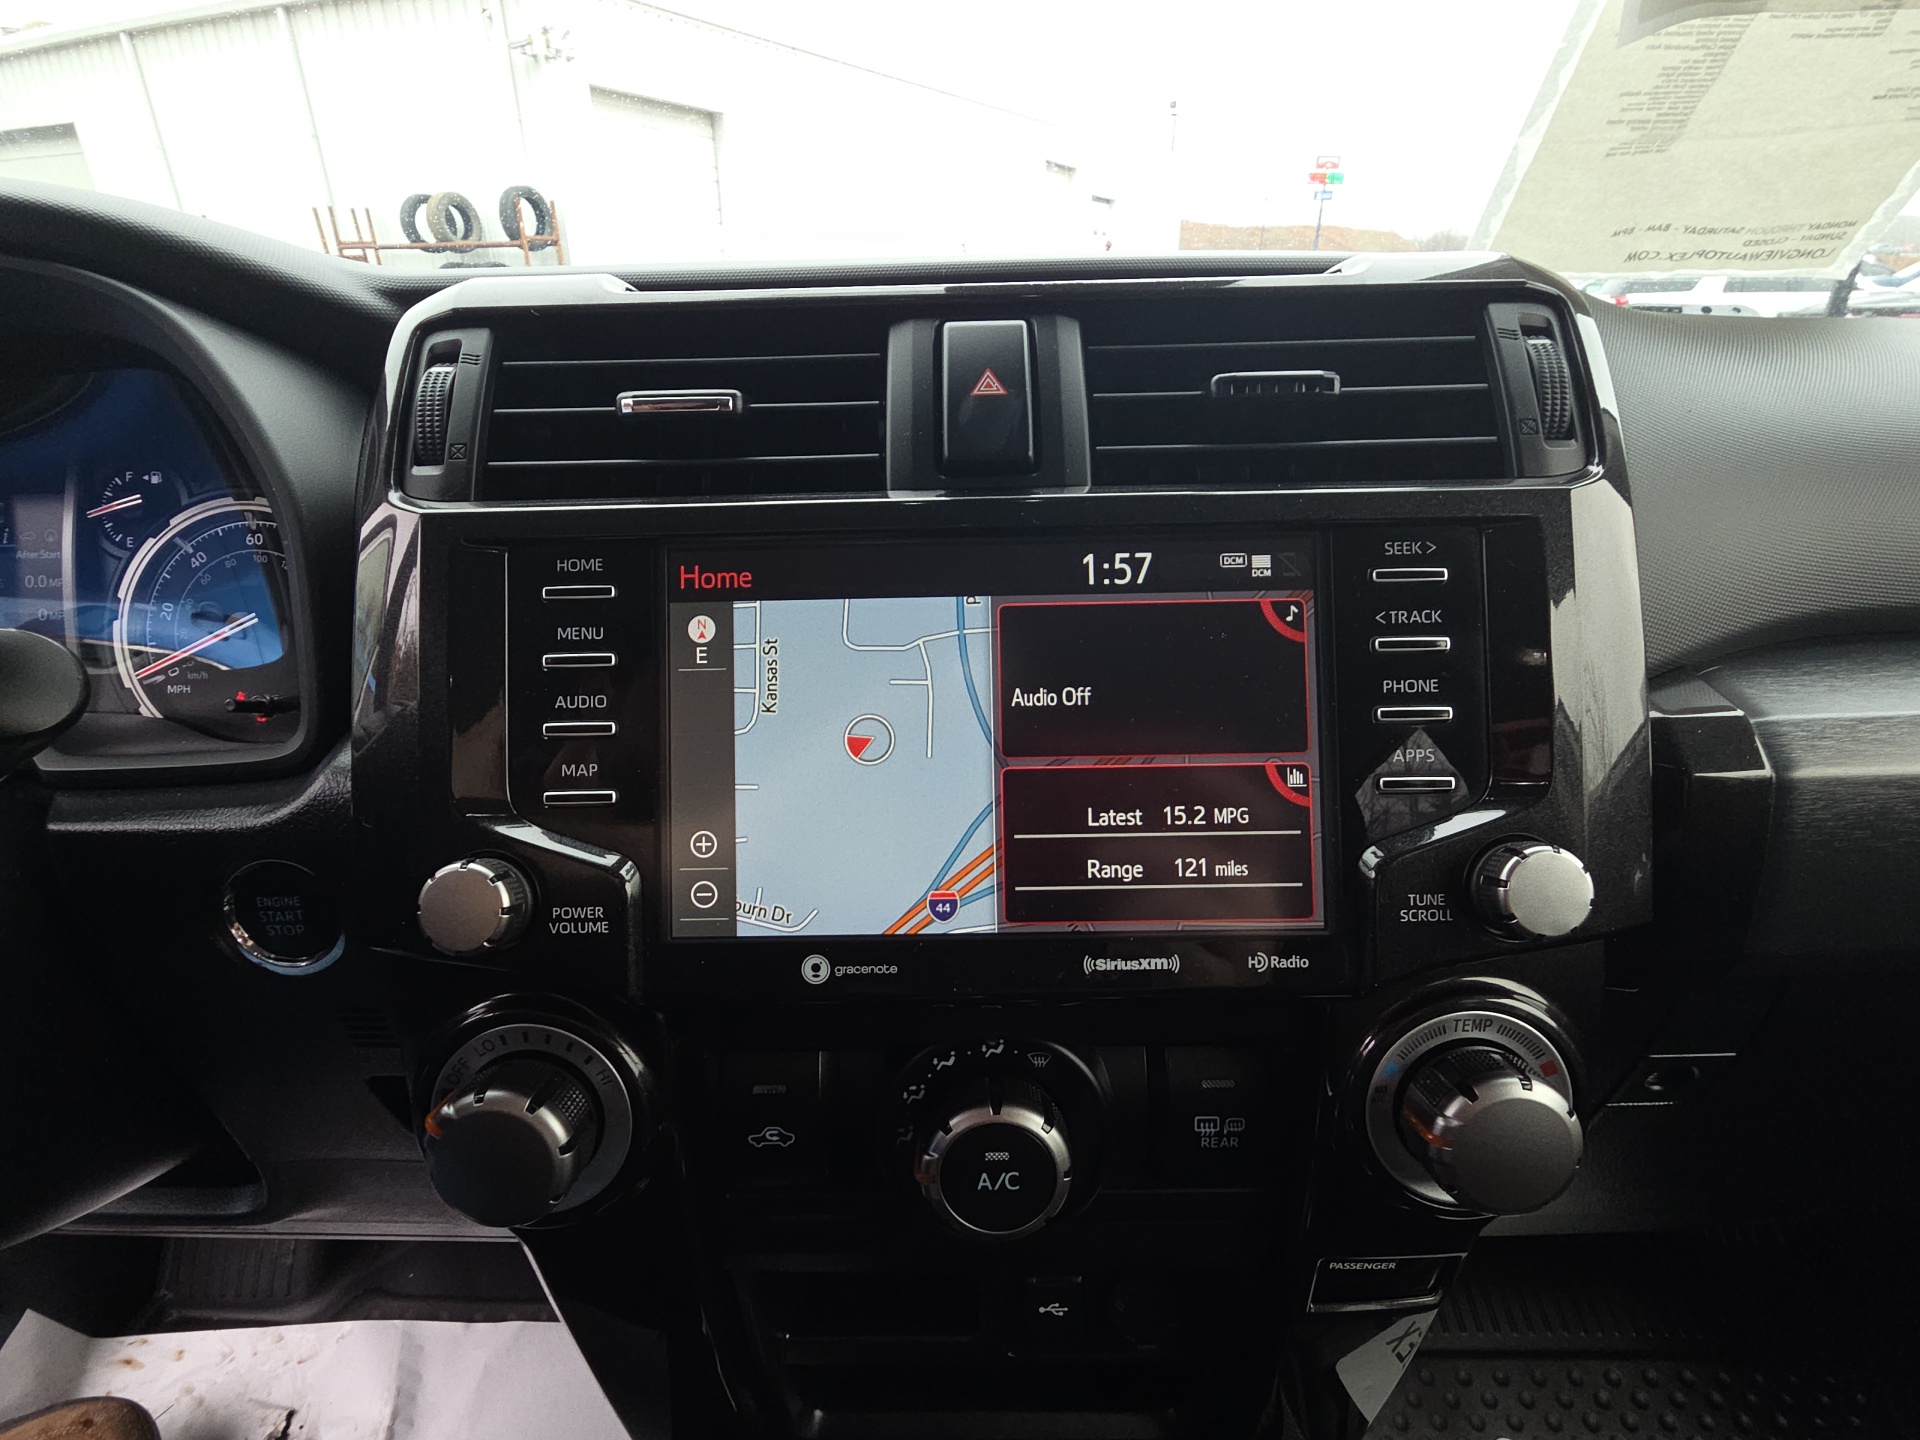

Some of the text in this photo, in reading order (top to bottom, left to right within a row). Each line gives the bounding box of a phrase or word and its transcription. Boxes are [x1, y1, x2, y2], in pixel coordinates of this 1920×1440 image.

[125, 471, 133, 482] F
[126, 537, 134, 548] E
[245, 533, 264, 545] 60
[1384, 541, 1422, 555] SEEK
[190, 551, 208, 568] 40
[224, 558, 237, 569] 80
[252, 554, 268, 563] 100
[556, 558, 604, 572] HOME
[1223, 556, 1244, 565] DCM
[1082, 552, 1153, 585] 1:57
[1251, 568, 1272, 577] DCM
[25, 575, 47, 588] 0.0
[680, 566, 753, 589] Home
[161, 602, 173, 621] 20
[1389, 610, 1443, 624] TRACK
[697, 618, 707, 630] N
[557, 627, 604, 640] MENU
[696, 647, 708, 664] E
[168, 667, 179, 677] 0
[187, 671, 208, 681] km/h
[761, 637, 778, 714] Kansas St
[167, 684, 191, 694] MPH
[1383, 679, 1439, 694] PHONE
[555, 695, 607, 709] AUDIO
[1011, 686, 1092, 707] Audio Off
[1392, 749, 1435, 763] APPS
[561, 764, 599, 778] MAP
[1087, 805, 1249, 826] Latest 15.2 MPG
[1087, 857, 1249, 882] Range 121 miles
[256, 896, 301, 907] ENGINE
[1407, 894, 1446, 906] TUNE
[552, 907, 604, 919] POWER
[771, 905, 793, 924] Dr
[935, 903, 951, 914] 44
[259, 910, 303, 922] START
[1400, 909, 1453, 922] SCROLL
[266, 924, 305, 936] STOP
[549, 922, 609, 934] VOLUME
[1270, 954, 1309, 968] Radio
[834, 964, 898, 977] gracenote
[1453, 1019, 1493, 1033] TEMP
[446, 1039, 496, 1085] OFF LO
[596, 1069, 612, 1086] HI
[1200, 1137, 1239, 1149] REAR
[977, 1172, 1020, 1192] A/C
[1329, 1262, 1397, 1270] PASSENGER
